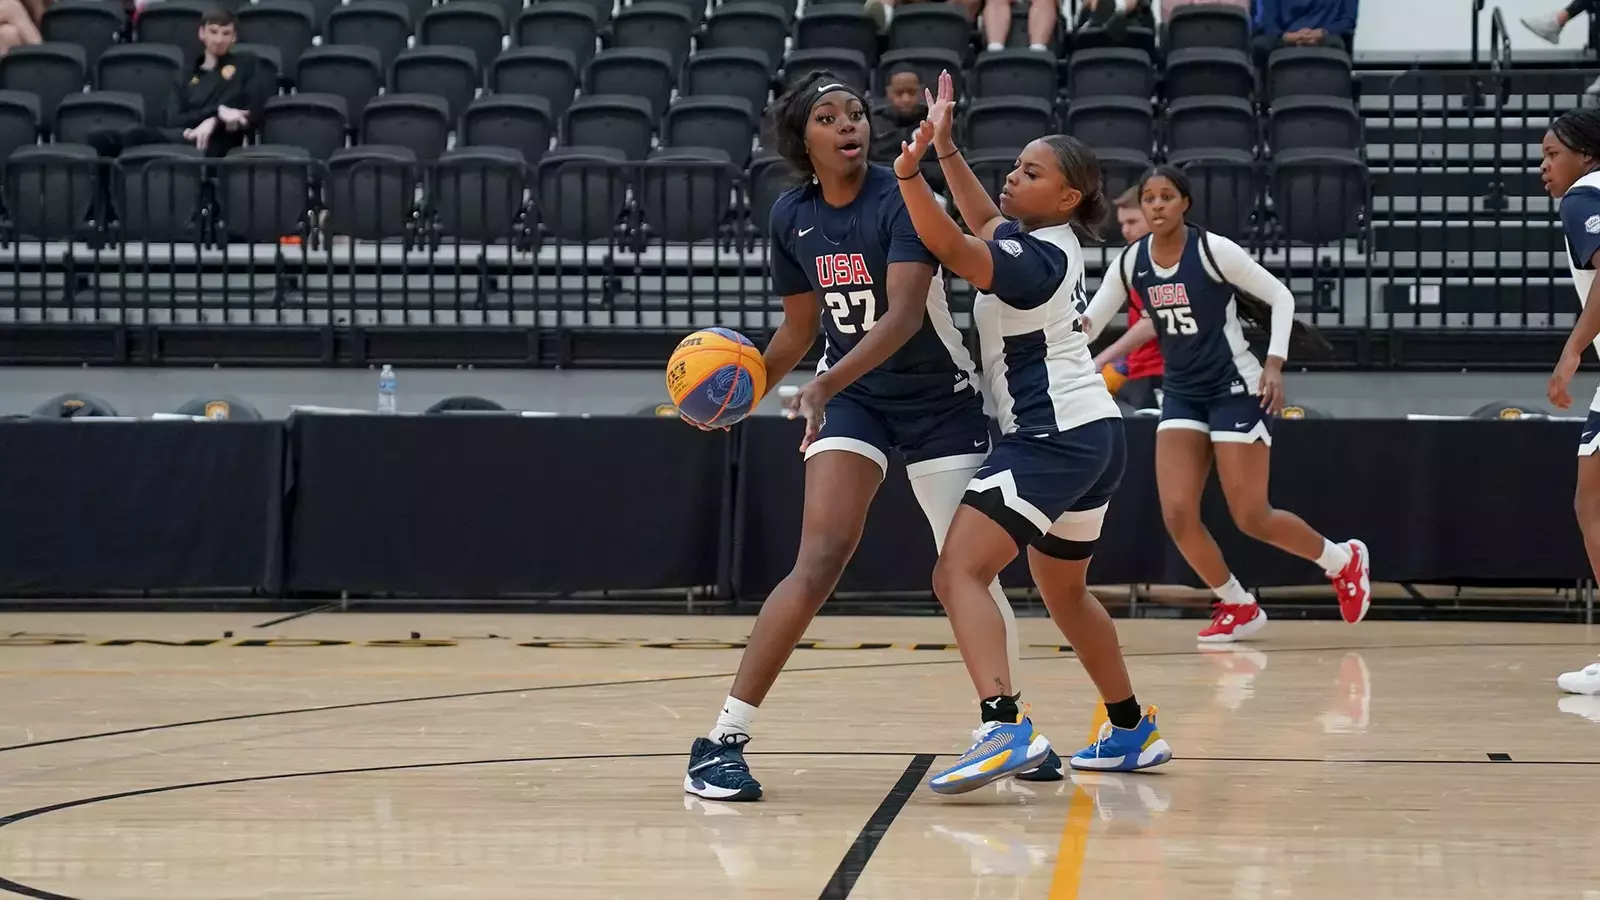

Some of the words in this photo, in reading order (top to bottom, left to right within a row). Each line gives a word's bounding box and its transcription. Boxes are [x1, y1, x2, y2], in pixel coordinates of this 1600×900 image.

[816, 254, 873, 287] USA
[1148, 283, 1189, 307] USA
[824, 289, 877, 334] 27
[1156, 306, 1198, 335] 75
